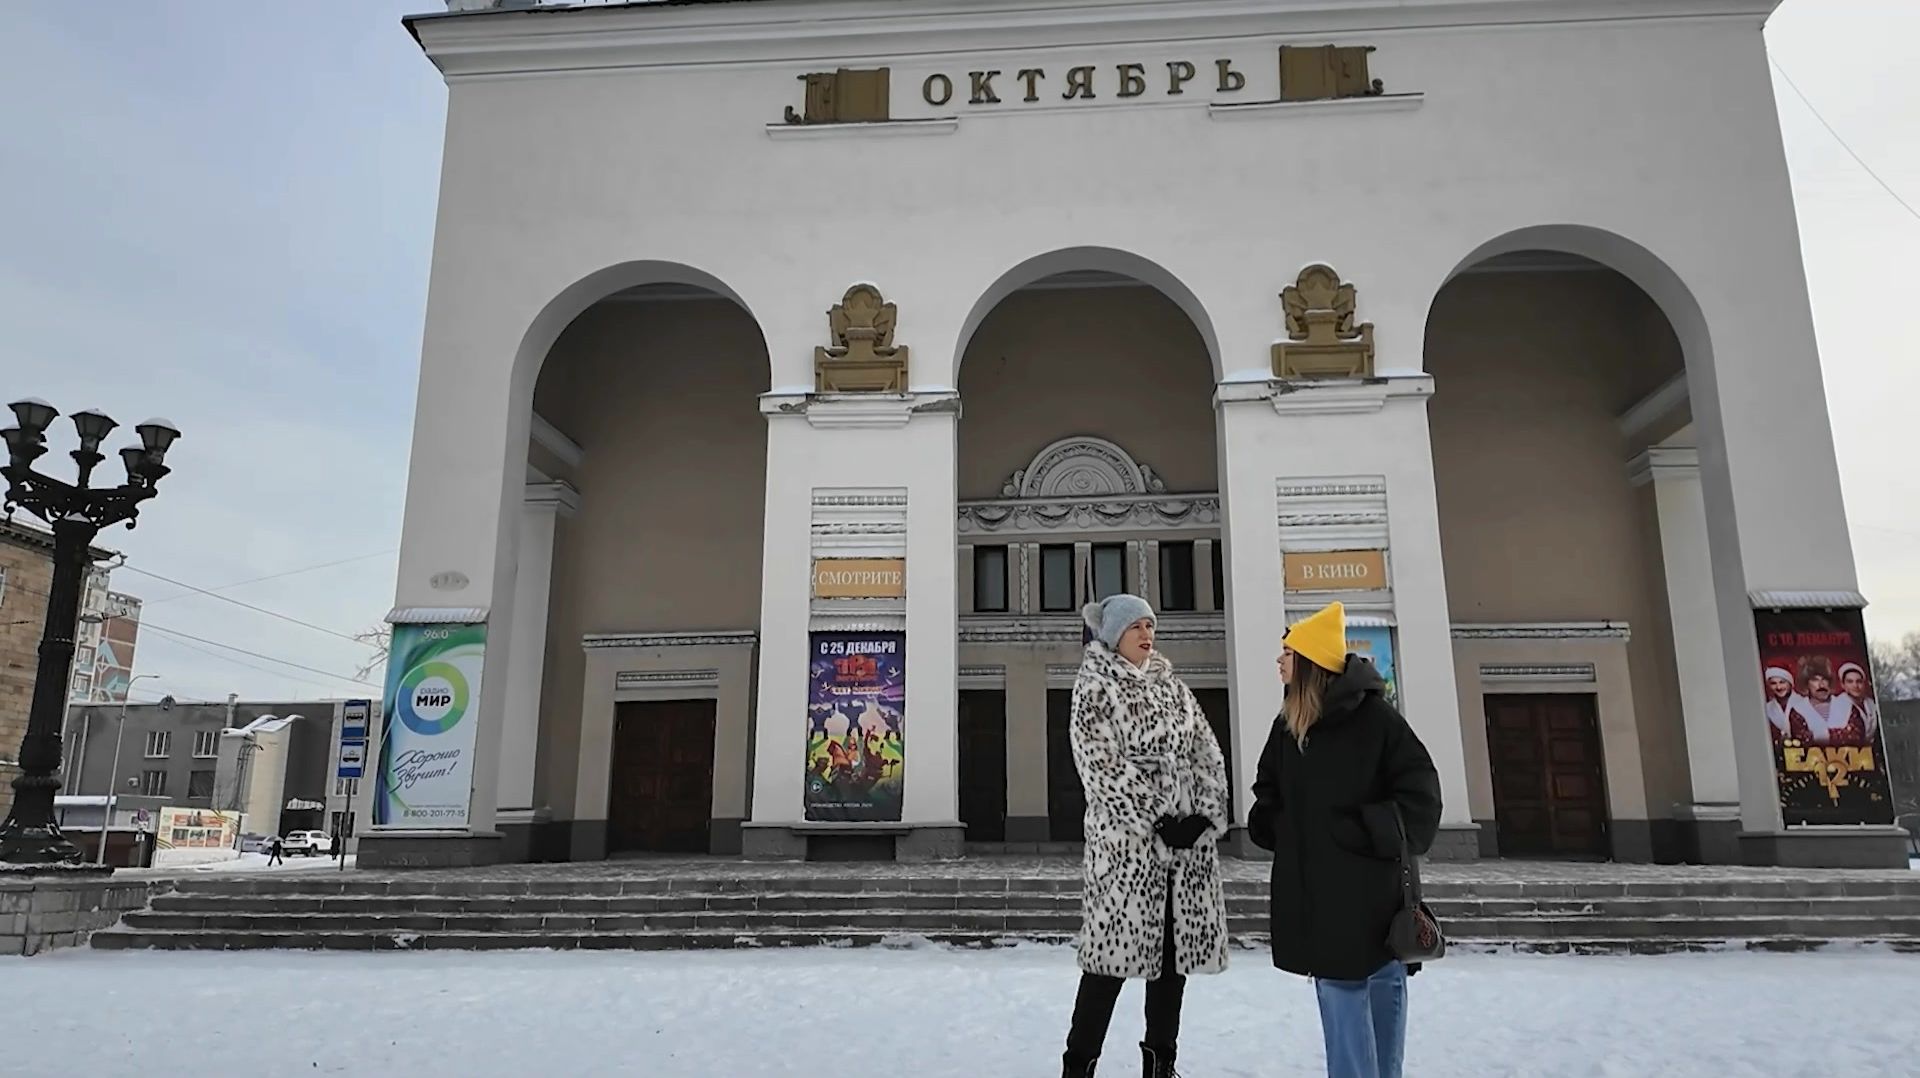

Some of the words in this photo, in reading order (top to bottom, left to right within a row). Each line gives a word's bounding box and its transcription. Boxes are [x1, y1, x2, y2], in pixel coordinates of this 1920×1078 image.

[922, 59, 1246, 106] ОКТЯБРЬ
[819, 571, 902, 585] СМОТРИТЕ
[1303, 565, 1314, 579] В
[1318, 563, 1368, 578] КИНО
[820, 642, 828, 654] С
[829, 642, 844, 654] 25
[846, 641, 896, 655] ДЕКАБРЯ
[416, 695, 451, 706] МИР
[393, 749, 461, 772] Хорошо
[1783, 739, 1875, 772] ЁЛКИ
[1814, 761, 1849, 786] 12
